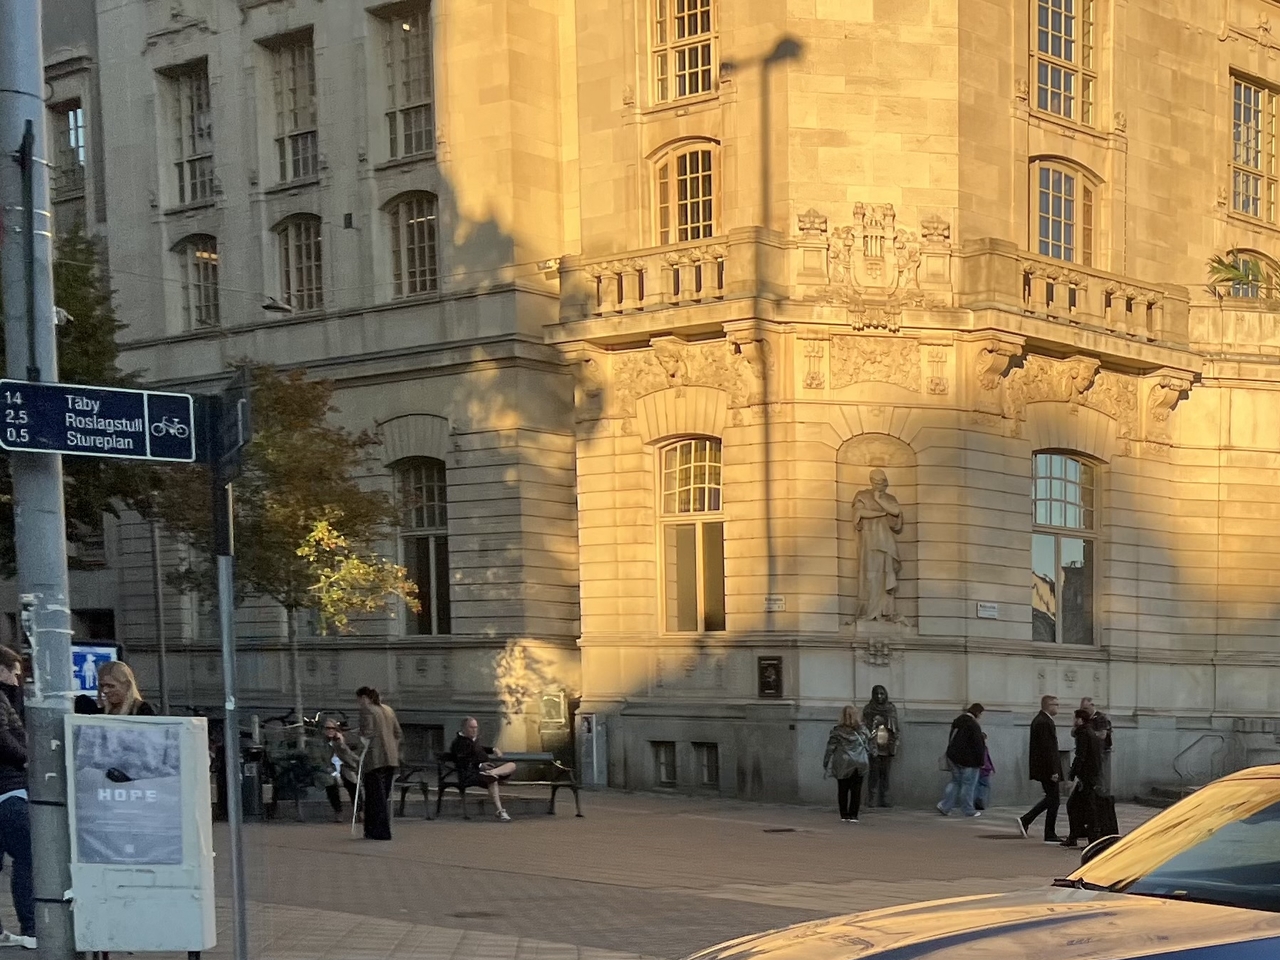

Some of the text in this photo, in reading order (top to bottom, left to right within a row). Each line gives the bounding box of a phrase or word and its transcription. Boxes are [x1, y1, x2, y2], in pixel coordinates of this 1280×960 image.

[5, 391, 22, 405] 14
[65, 412, 143, 433] Roslagstull
[66, 431, 134, 450] Stureplan
[97, 788, 157, 802] HOPE
